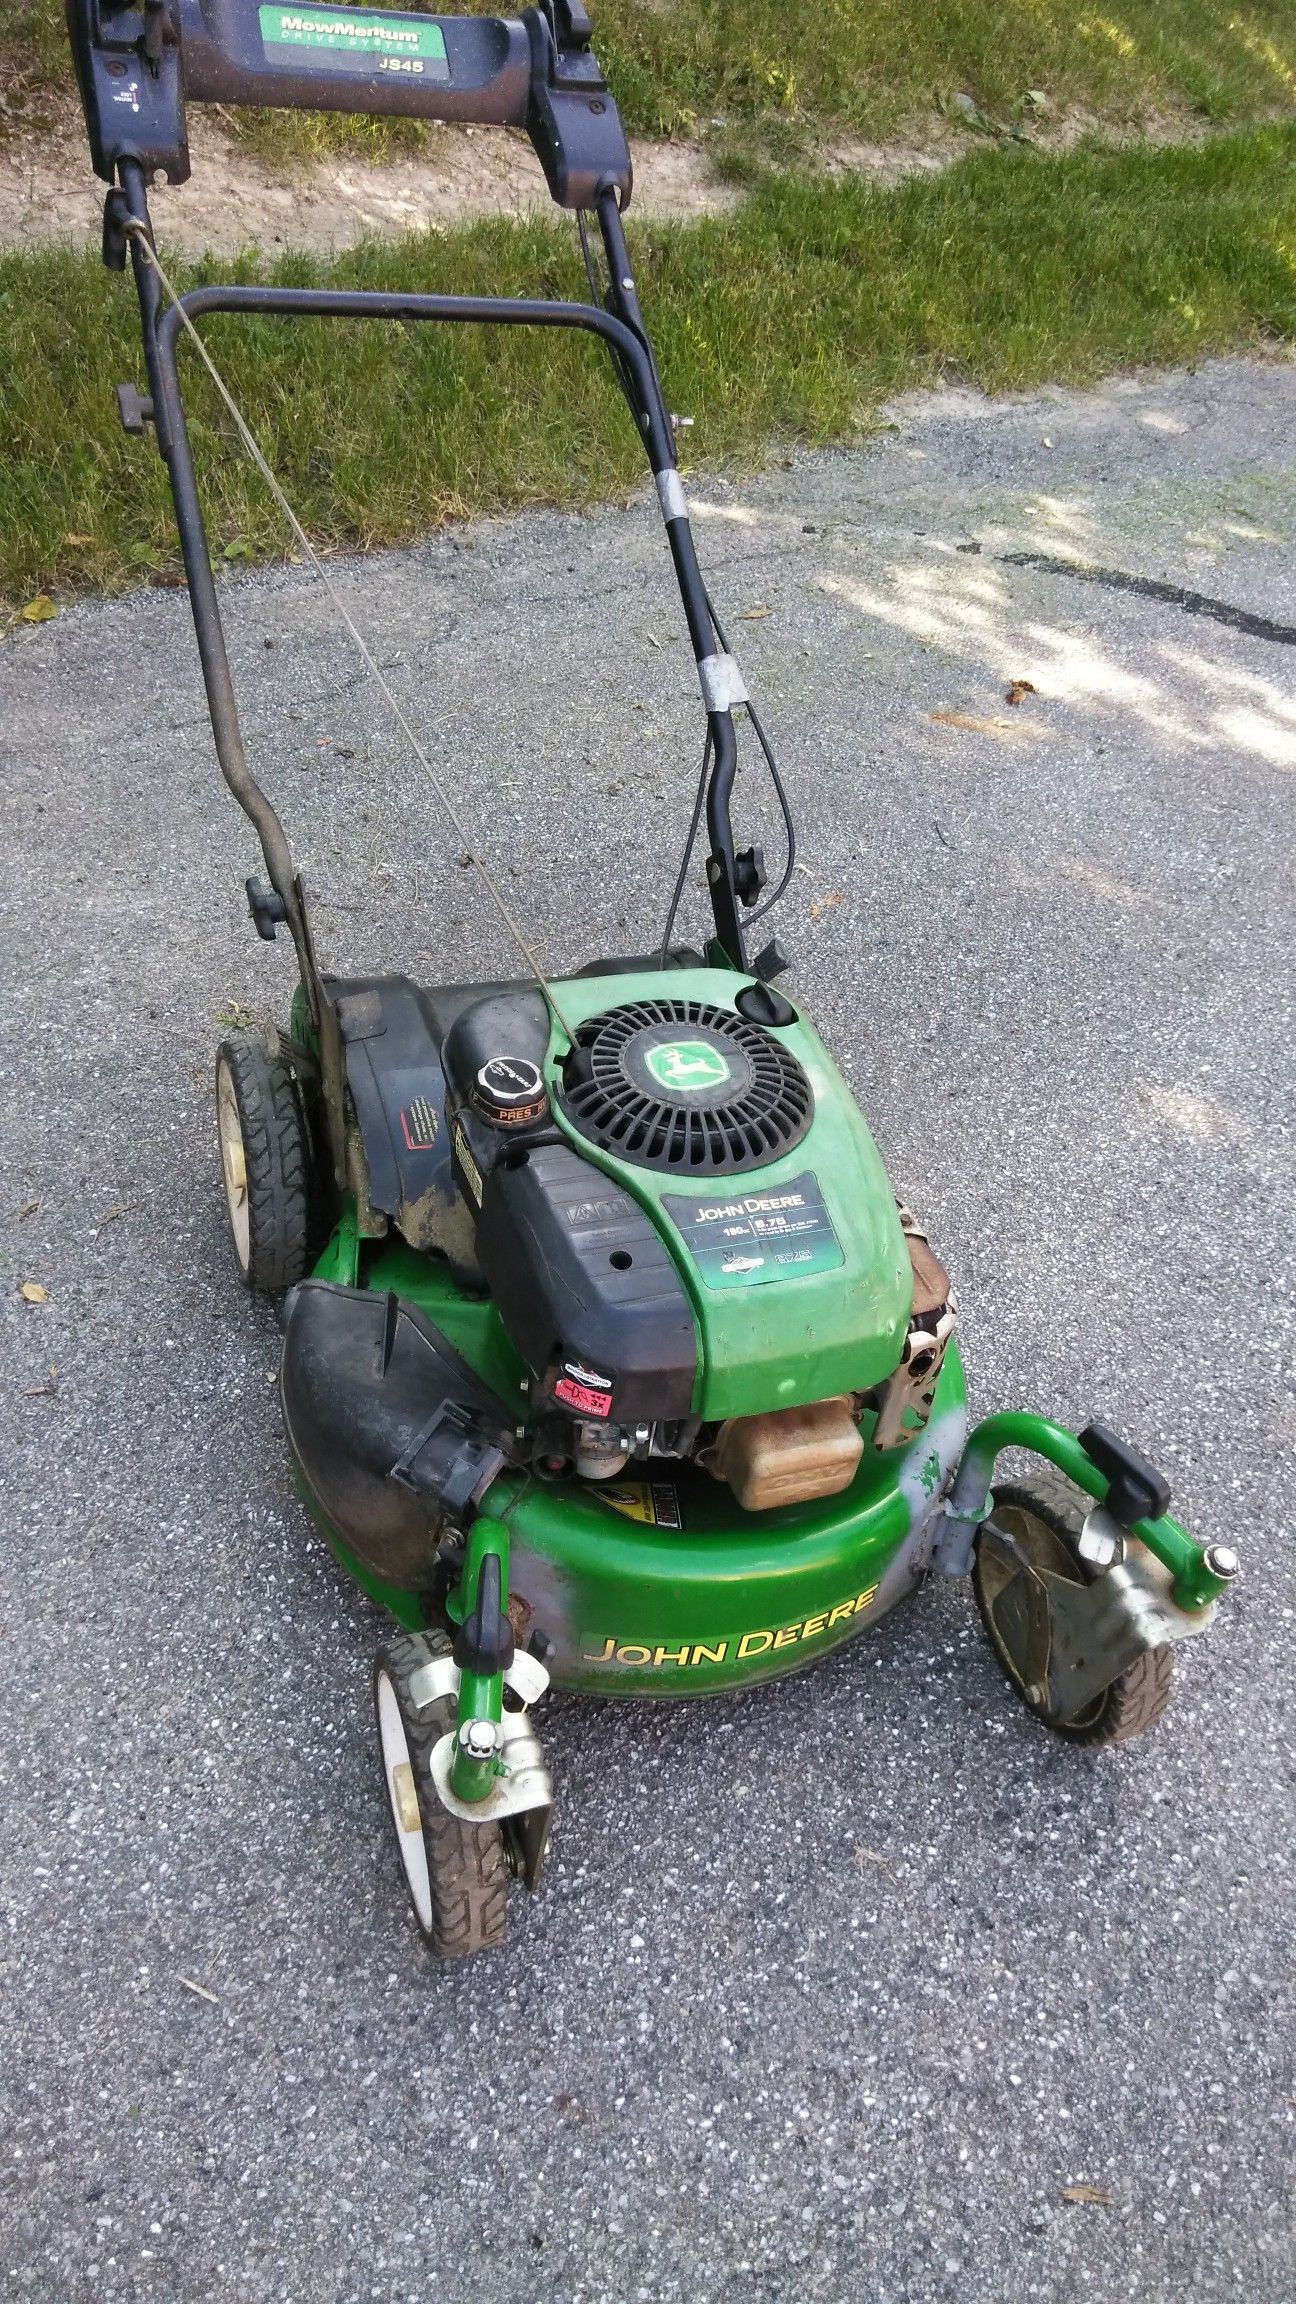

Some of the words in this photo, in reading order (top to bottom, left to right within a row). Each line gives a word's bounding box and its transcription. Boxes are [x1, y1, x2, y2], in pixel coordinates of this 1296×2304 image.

[281, 31, 335, 43] DRIVE
[350, 38, 419, 51] SYSTEM
[379, 58, 424, 73] JS45
[500, 1108, 532, 1120] PRES
[696, 1204, 745, 1223] JOHN
[744, 1194, 805, 1213] DEERE
[583, 1638, 728, 1667] JOHN
[736, 1581, 880, 1660] DEERE
